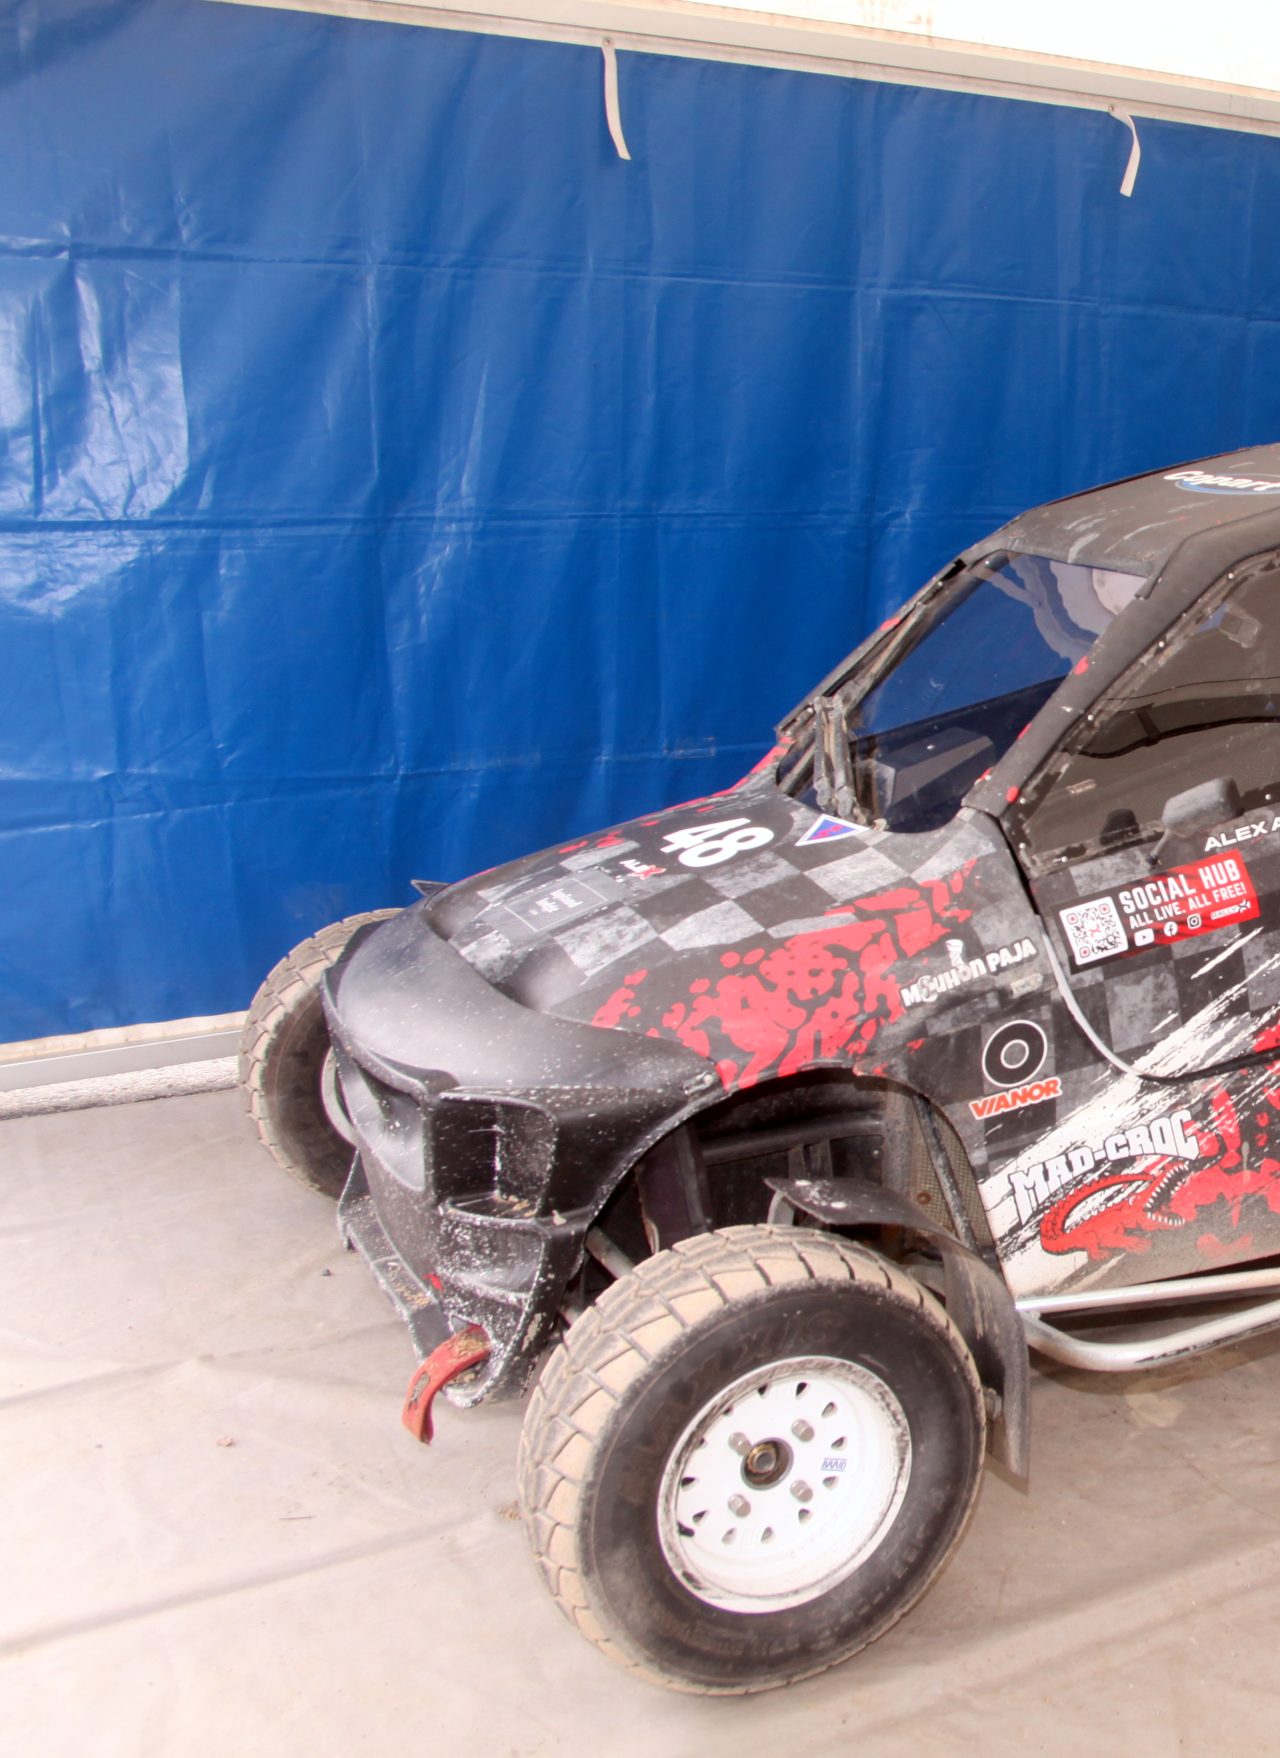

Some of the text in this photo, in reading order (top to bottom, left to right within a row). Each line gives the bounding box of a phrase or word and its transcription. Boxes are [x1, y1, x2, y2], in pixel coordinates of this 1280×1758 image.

[660, 817, 775, 868] 48
[1203, 820, 1269, 853] ALEX
[1118, 858, 1241, 915] SOCIAL HUB
[1129, 882, 1248, 930] ALL LIVE. ALL FREE!
[985, 938, 1038, 973] PAJA
[968, 1076, 1061, 1121] VIANOR
[1008, 1109, 1200, 1226] MAD-CROC
